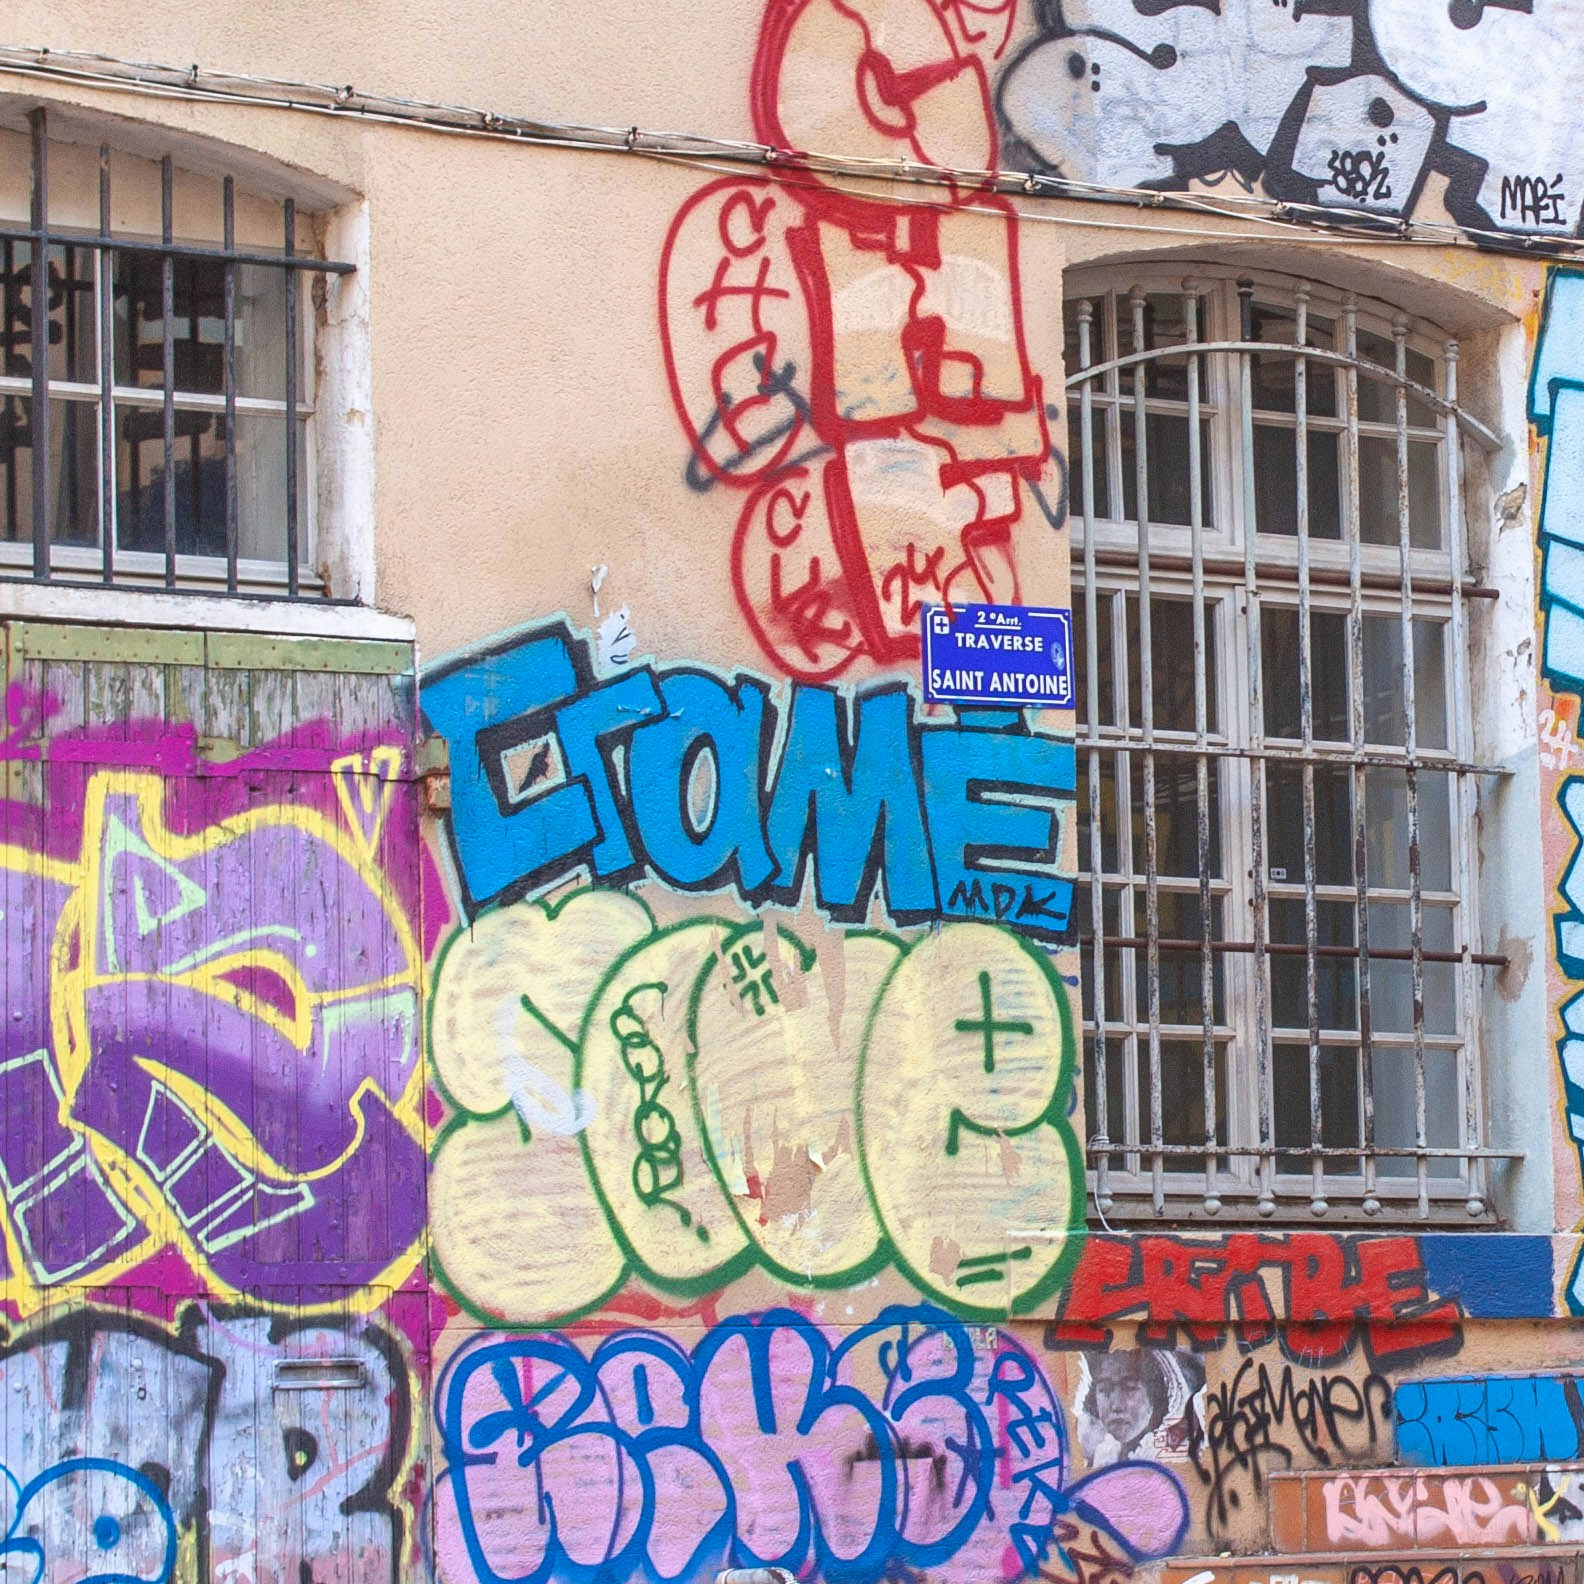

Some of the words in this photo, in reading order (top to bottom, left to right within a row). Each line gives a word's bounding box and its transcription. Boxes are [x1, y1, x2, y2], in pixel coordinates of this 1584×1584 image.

[955, 632, 1044, 653] TRAVERSE
[932, 669, 985, 691] SAINT
[989, 672, 1068, 696] ANTOINE
